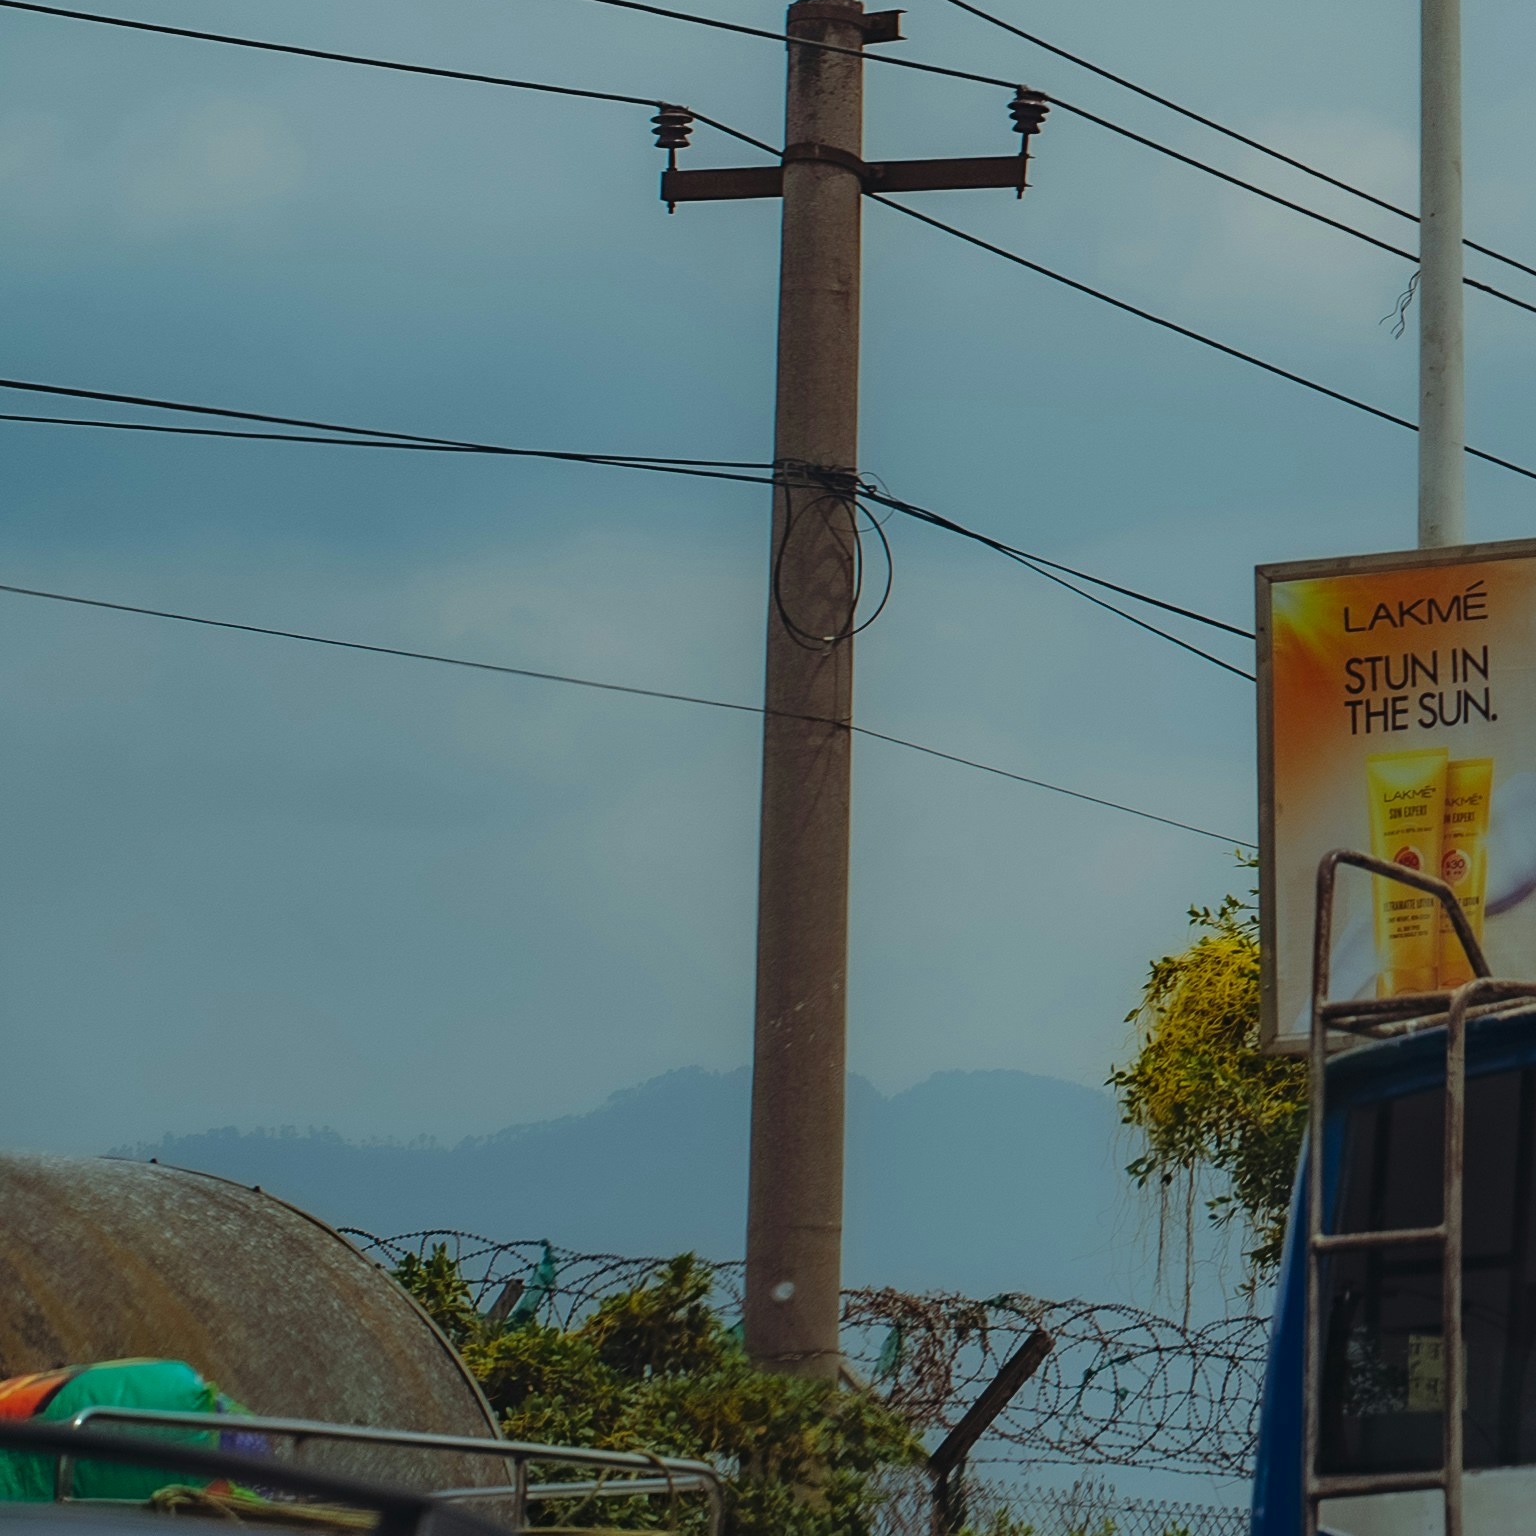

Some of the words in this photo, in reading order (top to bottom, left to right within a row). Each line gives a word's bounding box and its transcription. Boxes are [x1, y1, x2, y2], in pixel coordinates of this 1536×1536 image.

[1343, 580, 1489, 633] LAKMÉ
[1344, 651, 1438, 695] STUN
[1452, 645, 1489, 684] IN
[1344, 694, 1409, 736] THE
[1418, 687, 1498, 727] SUN.
[1404, 805, 1428, 818] EXPERT
[1445, 792, 1479, 807] AKMÉ
[1452, 811, 1475, 824] EXPERT
